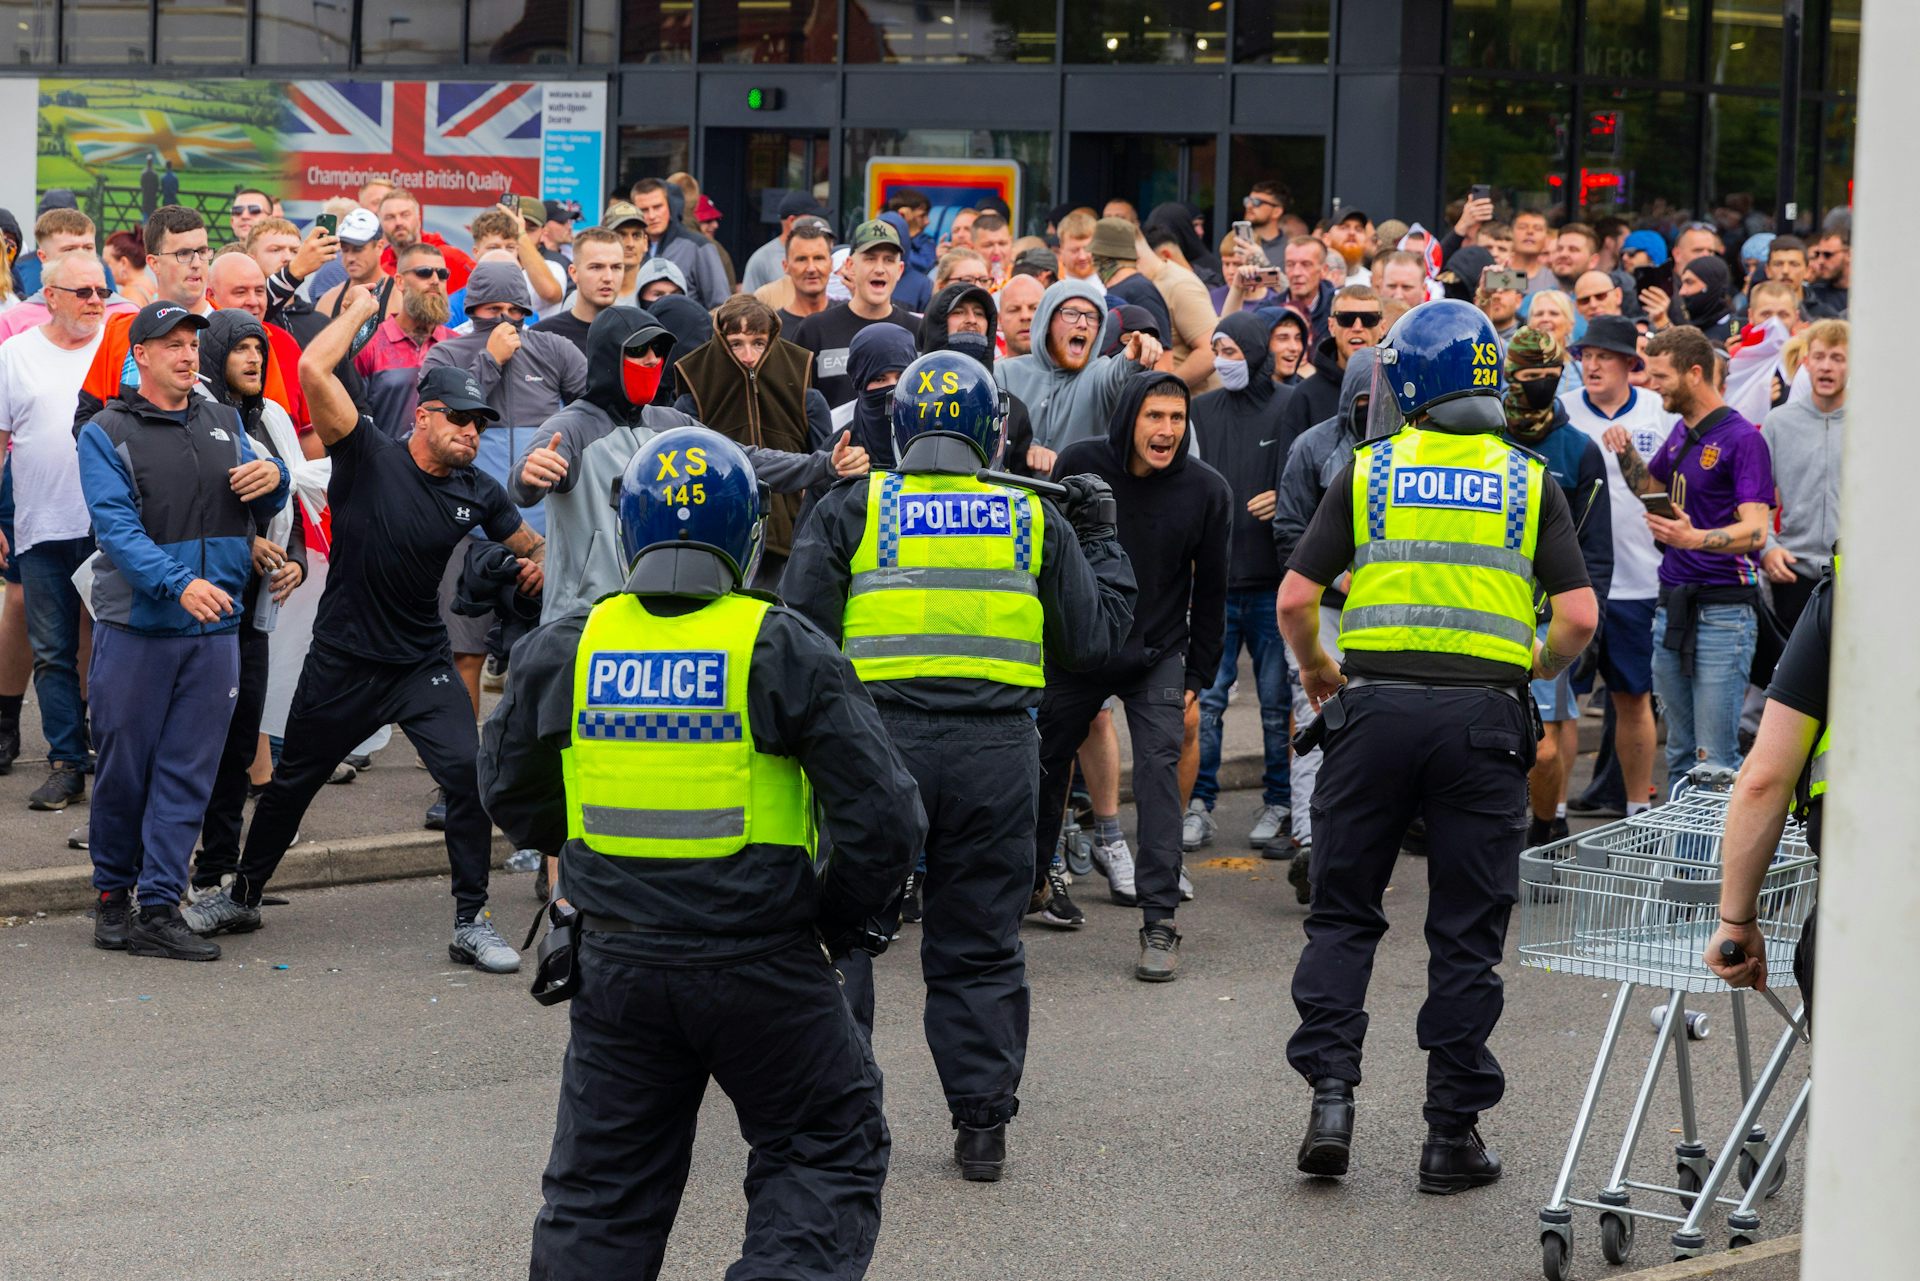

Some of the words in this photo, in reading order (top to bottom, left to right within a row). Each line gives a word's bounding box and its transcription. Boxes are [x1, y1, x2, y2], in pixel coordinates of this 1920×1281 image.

[391, 168, 424, 188] Great
[425, 169, 465, 190] British
[466, 171, 512, 194] Quality
[1471, 342, 1497, 366] XS
[1472, 367, 1498, 387] 234
[918, 401, 960, 419] 770
[662, 483, 706, 506] 145
[1397, 471, 1499, 505] POLICE
[906, 500, 1006, 529] POLICE
[592, 658, 719, 699] POLICE
